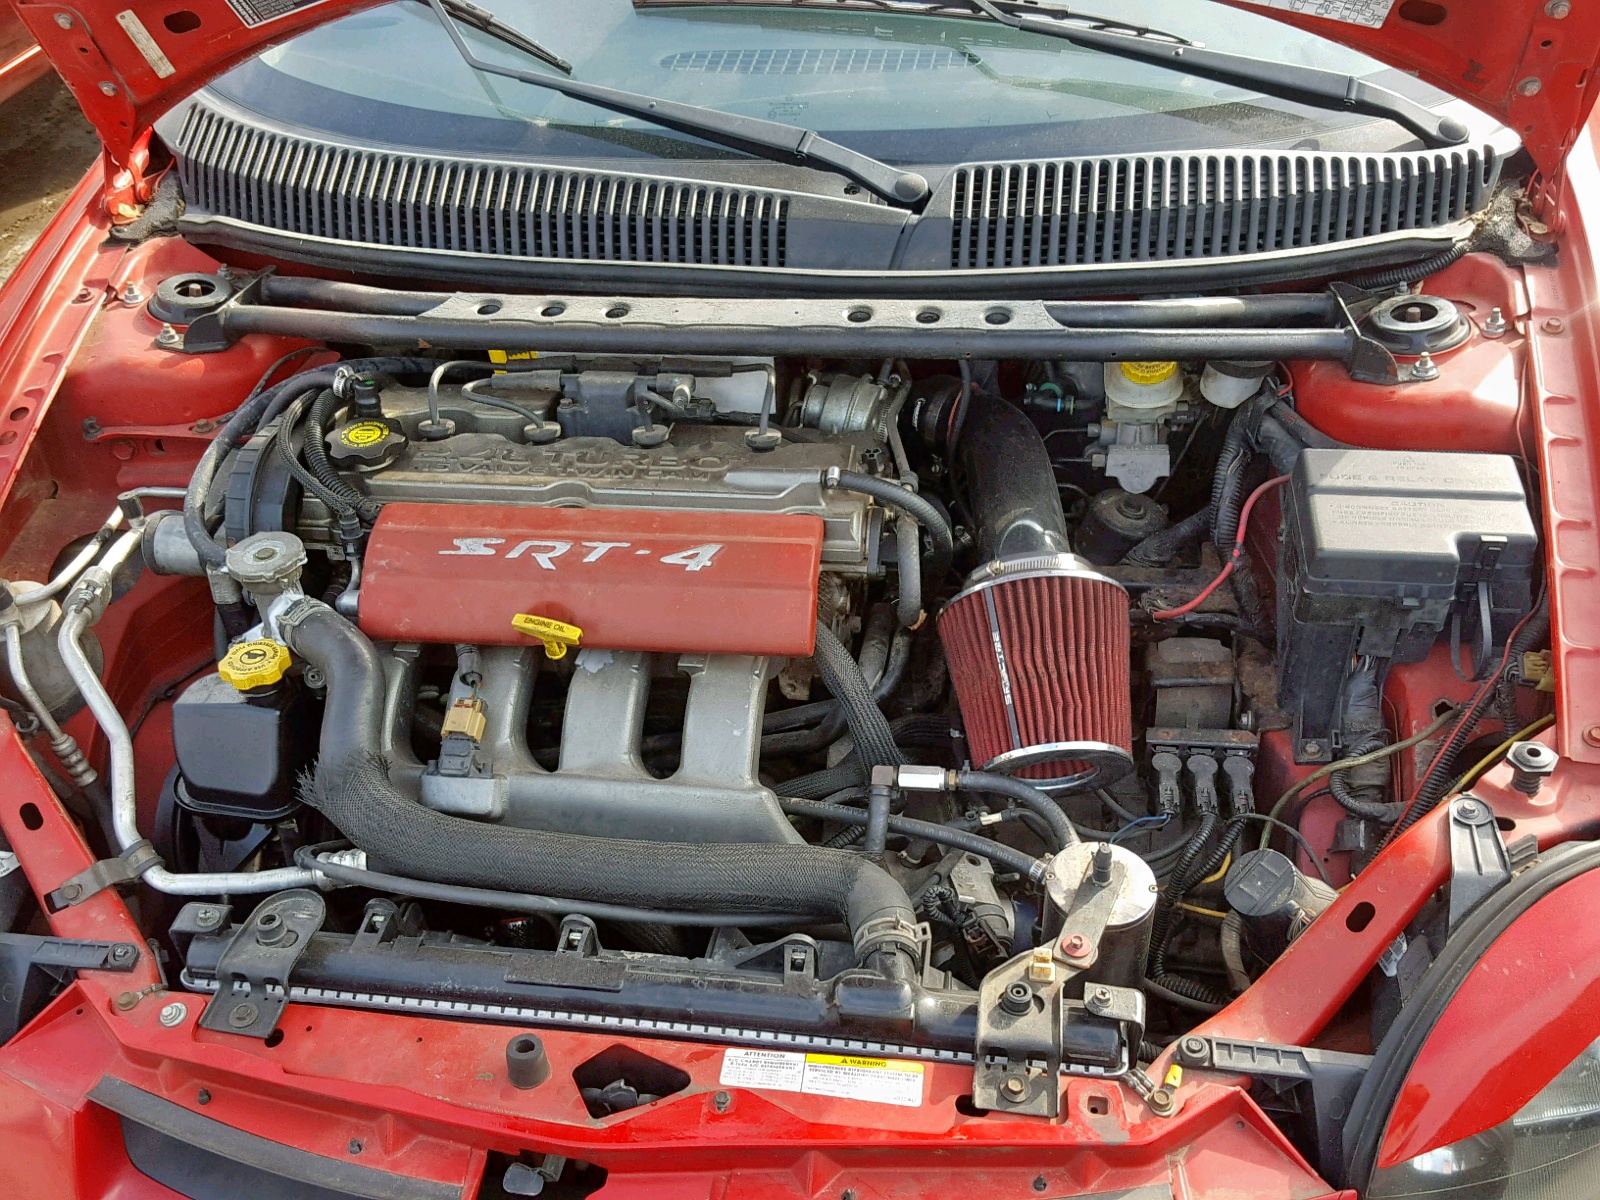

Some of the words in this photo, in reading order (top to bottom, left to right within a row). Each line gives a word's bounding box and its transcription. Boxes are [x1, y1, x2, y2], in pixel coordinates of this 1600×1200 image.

[231, 0, 254, 25] WARNIN
[543, 451, 730, 472] TURBO
[459, 464, 546, 476] VALVE
[1385, 475, 1436, 483] RELAY
[523, 616, 553, 629] ENGINE
[553, 624, 567, 633] OIL
[744, 1050, 786, 1059] ATTENTION
[849, 1059, 887, 1068] WARNING
